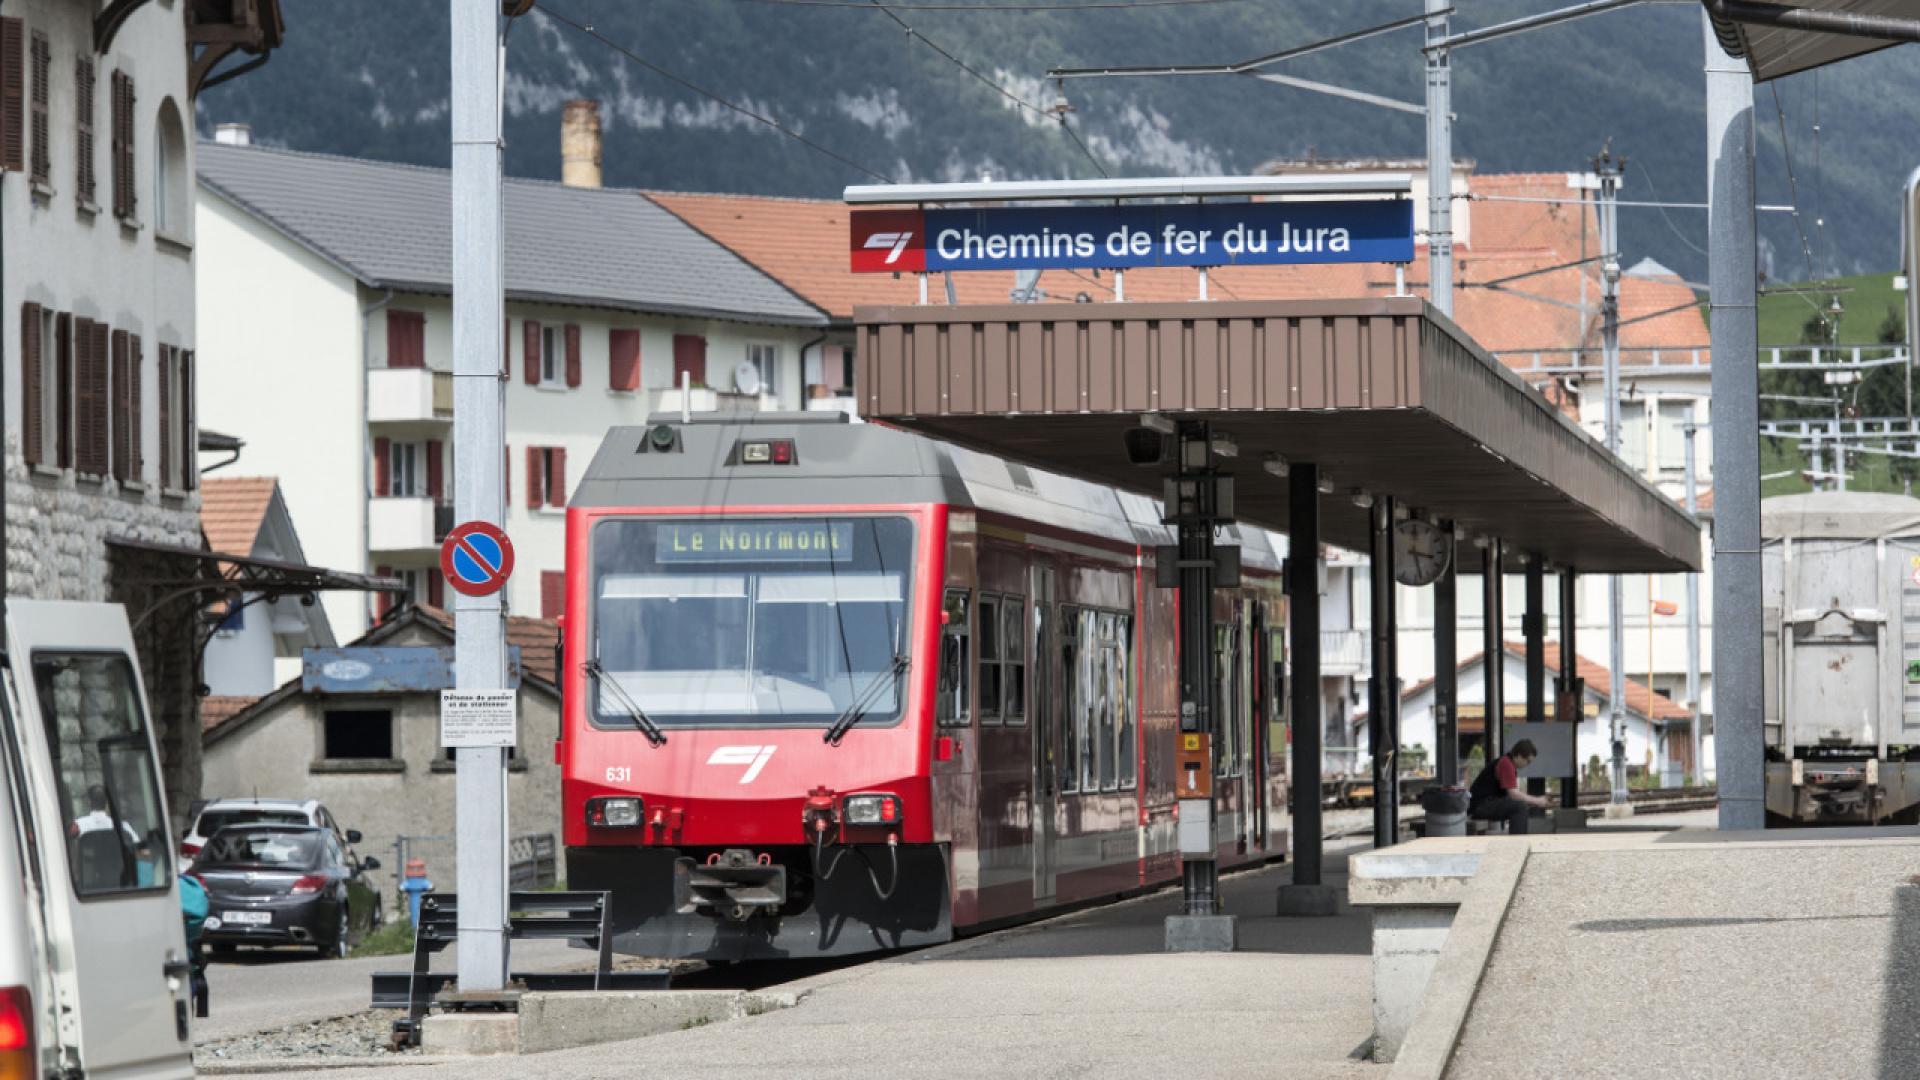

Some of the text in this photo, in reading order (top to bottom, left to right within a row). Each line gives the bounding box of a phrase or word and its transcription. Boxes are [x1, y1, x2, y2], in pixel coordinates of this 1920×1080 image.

[936, 222, 1350, 259] Chemins de fer du Jura
[674, 527, 840, 551] Le Noirmont
[606, 767, 631, 782] 631
